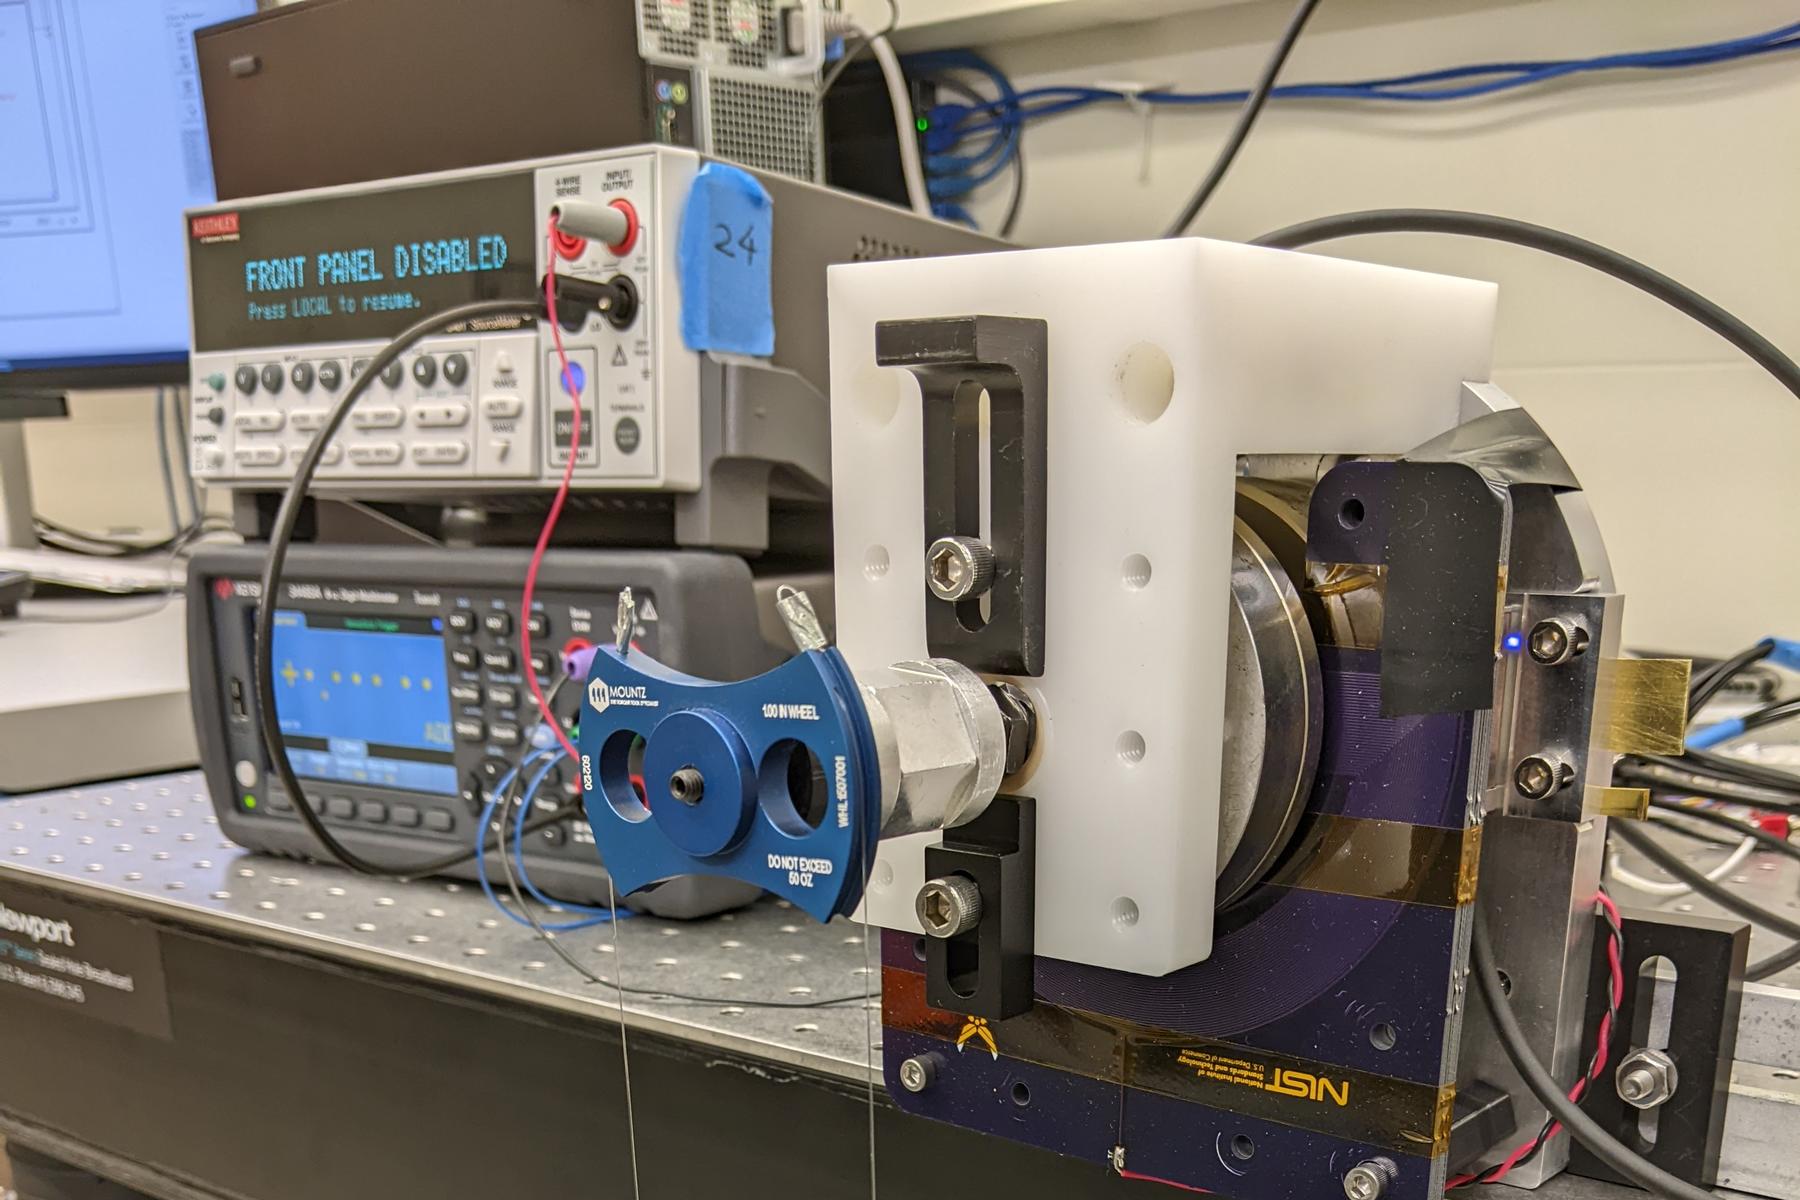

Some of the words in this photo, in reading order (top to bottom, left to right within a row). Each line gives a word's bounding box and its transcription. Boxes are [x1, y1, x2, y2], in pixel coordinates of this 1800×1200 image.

[713, 224, 758, 266] 24
[245, 256, 306, 292] FRONT
[316, 248, 384, 286] PANEL
[394, 234, 508, 278] DISABLED
[248, 302, 287, 321] Press
[292, 297, 333, 317] LOCAL
[338, 294, 356, 314] to
[362, 293, 422, 312] resume.
[609, 686, 647, 699] MOUNTZ
[788, 704, 820, 721] WHEEL
[767, 853, 781, 869] DO
[781, 855, 799, 871] NOT
[799, 857, 833, 875] EXCEED
[800, 873, 814, 888] OZ
[0, 903, 75, 947] ewport
[1177, 1055, 1214, 1071] Technology
[1181, 1049, 1211, 1062] Commerce
[1218, 1056, 1251, 1069] Department
[1215, 1064, 1229, 1073] and
[1229, 1067, 1264, 1080] Standards
[1252, 1062, 1265, 1072] U.S.
[1206, 1071, 1233, 1083] Institute
[1233, 1075, 1264, 1089] National
[1264, 1067, 1350, 1107] NIST
